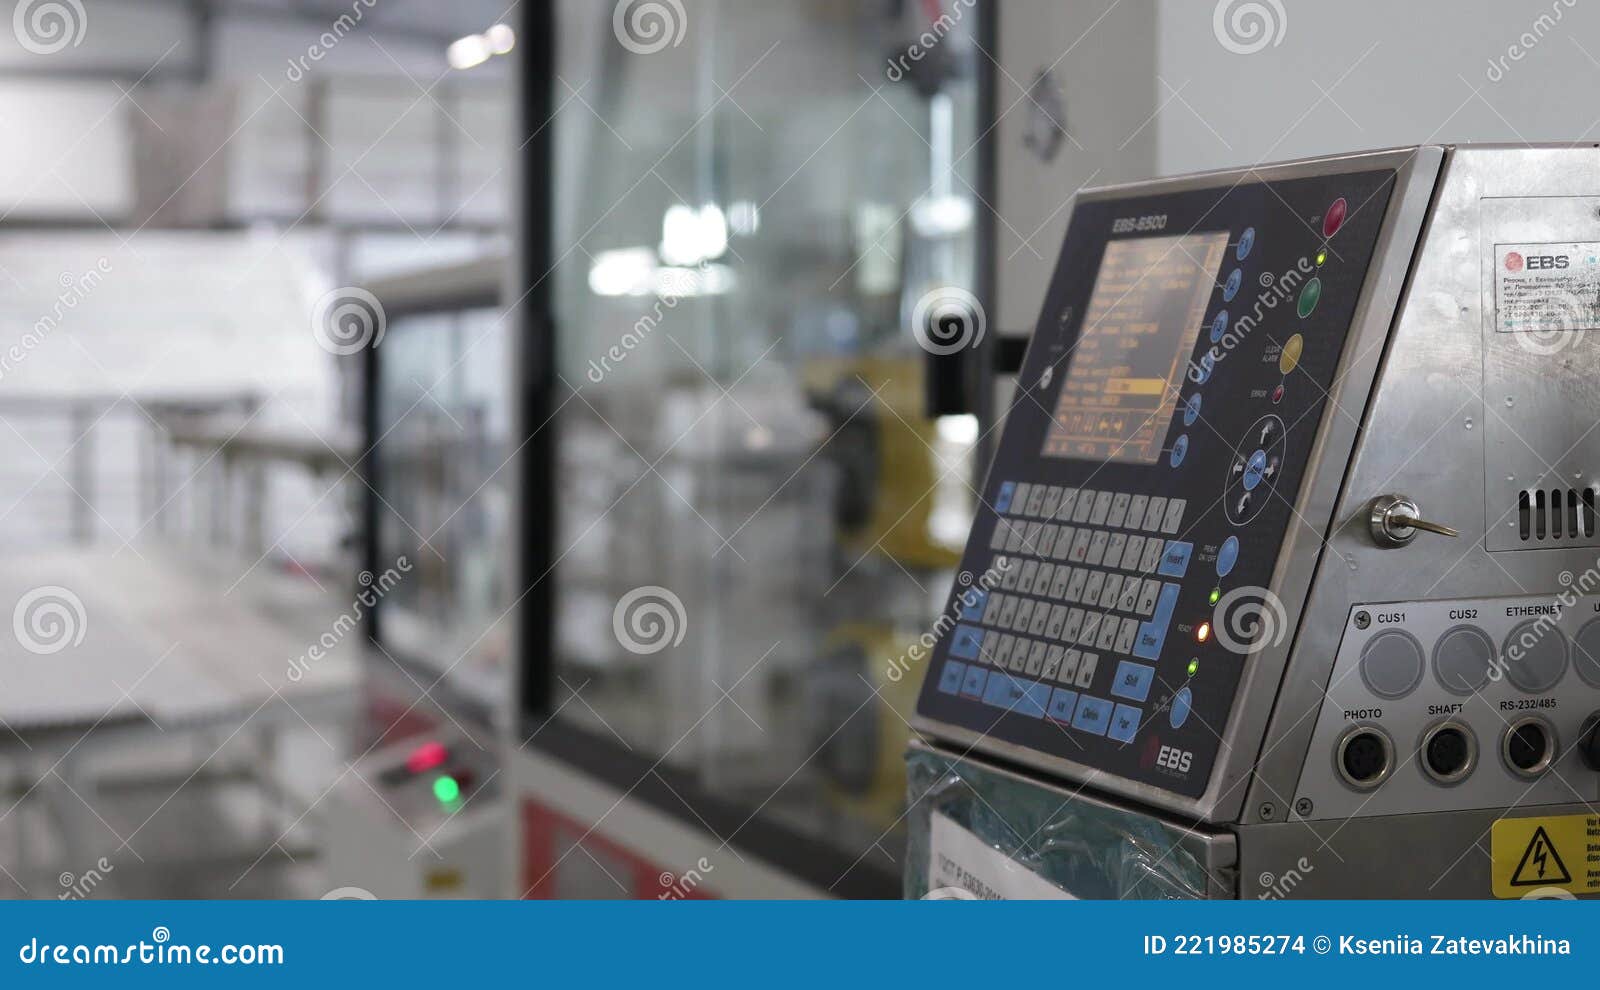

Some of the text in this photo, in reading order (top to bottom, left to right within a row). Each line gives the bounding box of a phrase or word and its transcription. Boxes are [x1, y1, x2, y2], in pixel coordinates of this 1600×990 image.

[1526, 255, 1570, 270] EBS
[1449, 609, 1478, 620] CUS2
[1506, 604, 1563, 617] ETHERNET
[1377, 612, 1406, 624] CUS1
[1428, 703, 1464, 715] SHAFT
[1500, 698, 1557, 711] RS-232/485
[1344, 708, 1383, 720] PHOTO
[1156, 744, 1193, 773] EBS
